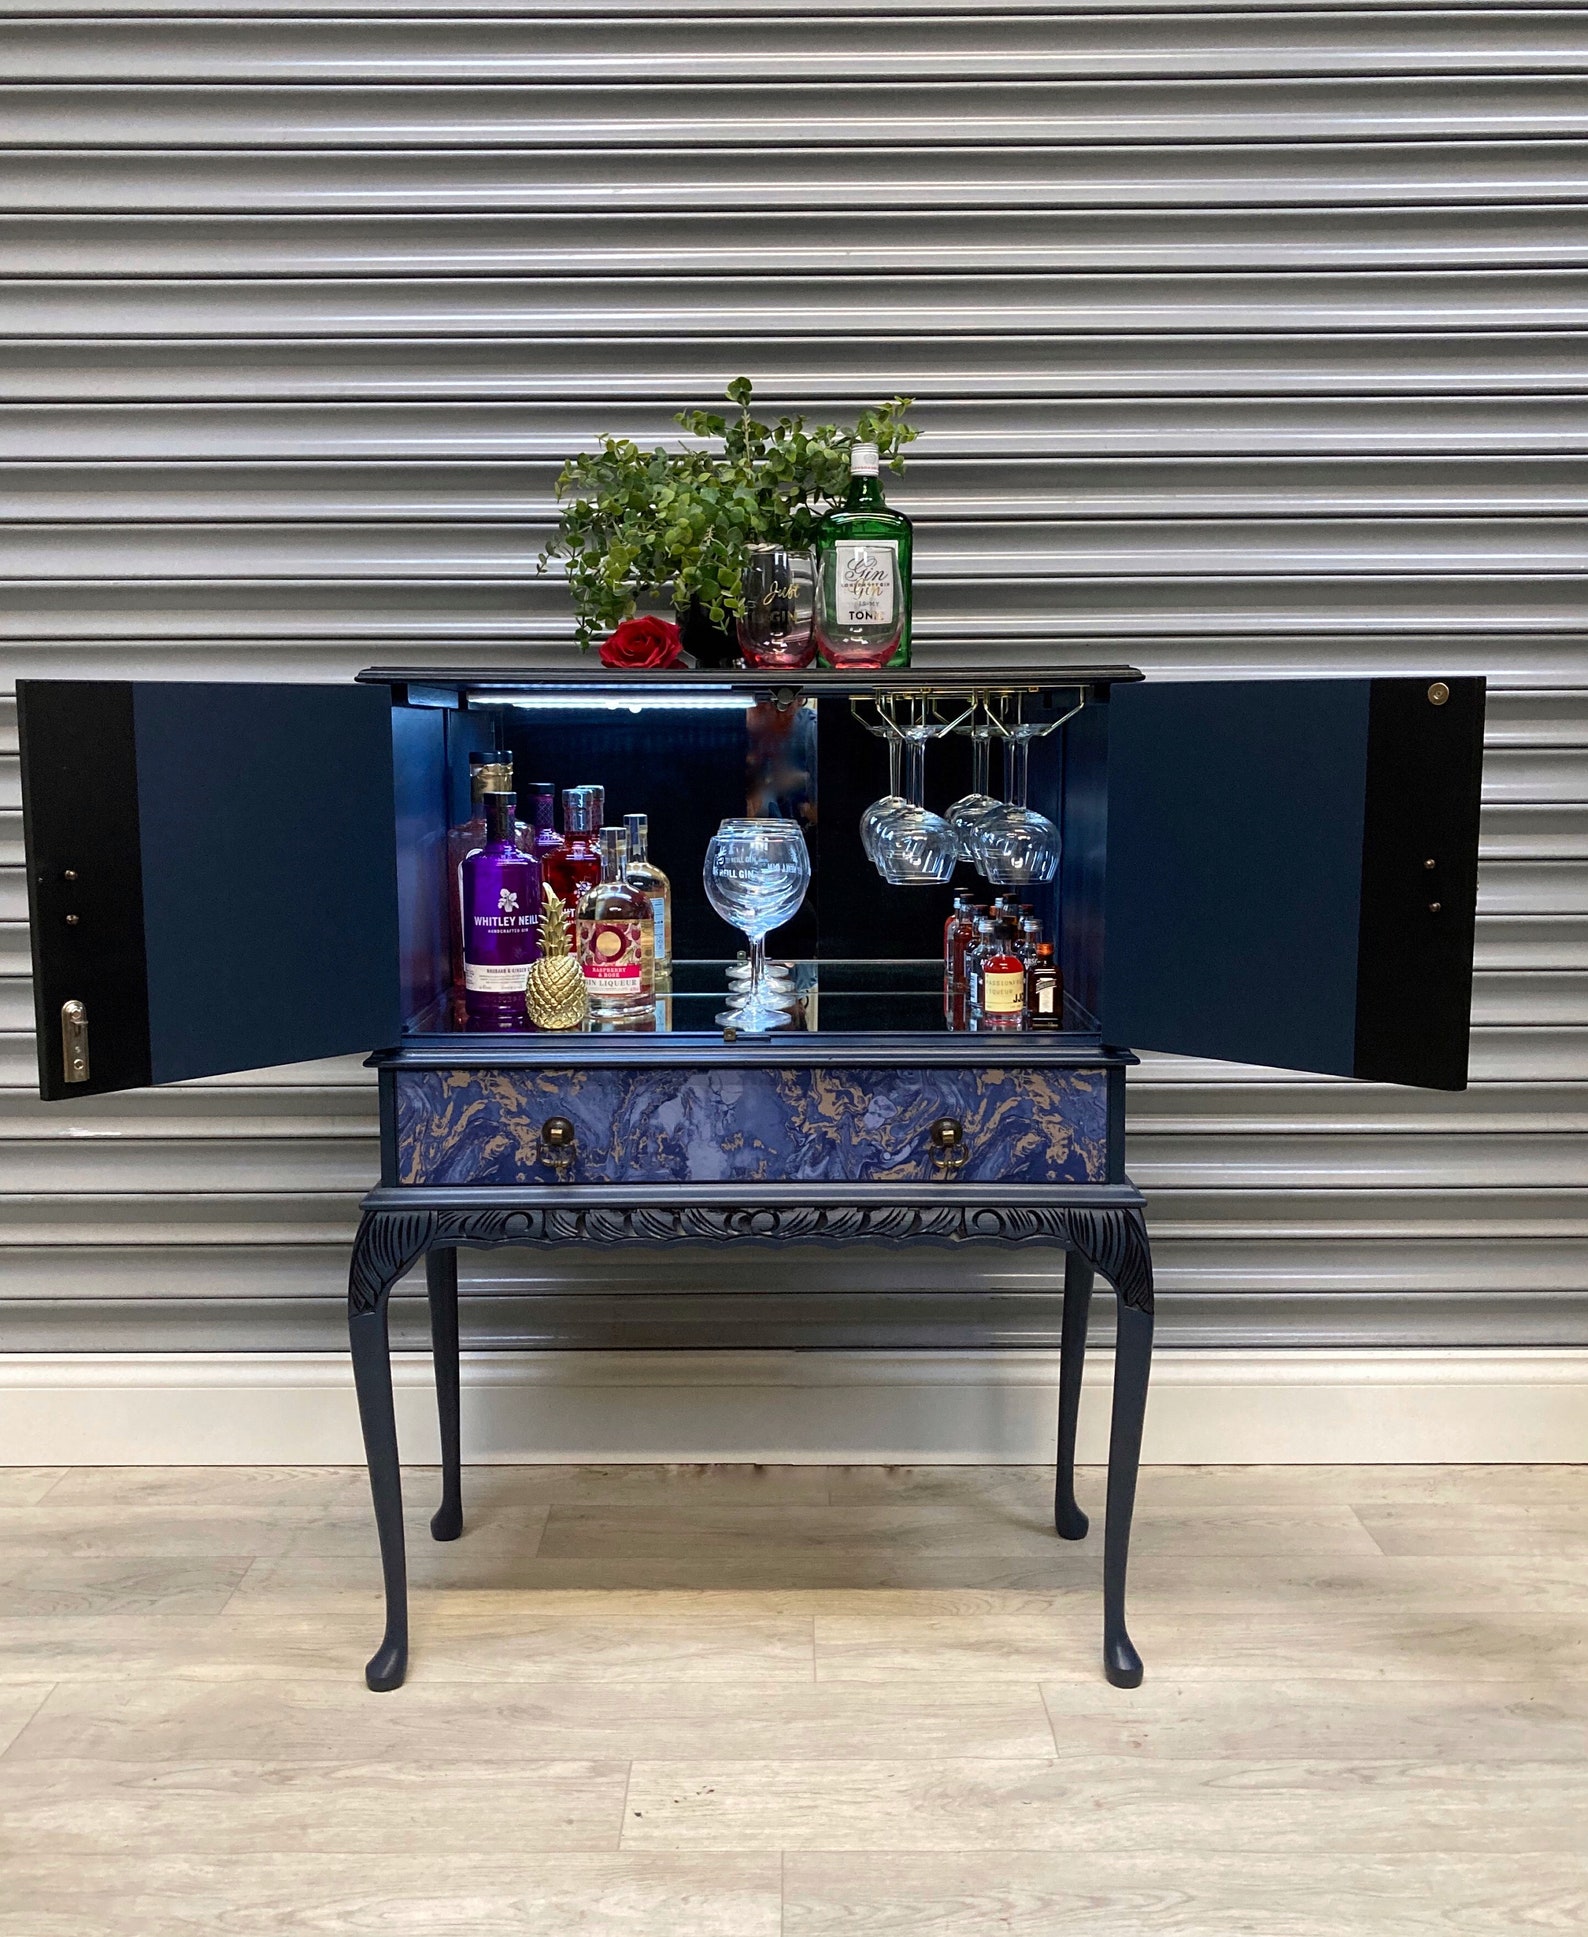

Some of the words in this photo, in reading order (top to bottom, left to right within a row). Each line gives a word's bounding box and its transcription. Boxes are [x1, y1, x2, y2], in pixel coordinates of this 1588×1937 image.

[844, 556, 889, 581] Gin
[763, 580, 800, 606] Just
[738, 869, 755, 879] GIN
[473, 915, 516, 927] WHITLEY
[518, 914, 539, 926] NEILL
[598, 979, 637, 987] LIQUEUR
